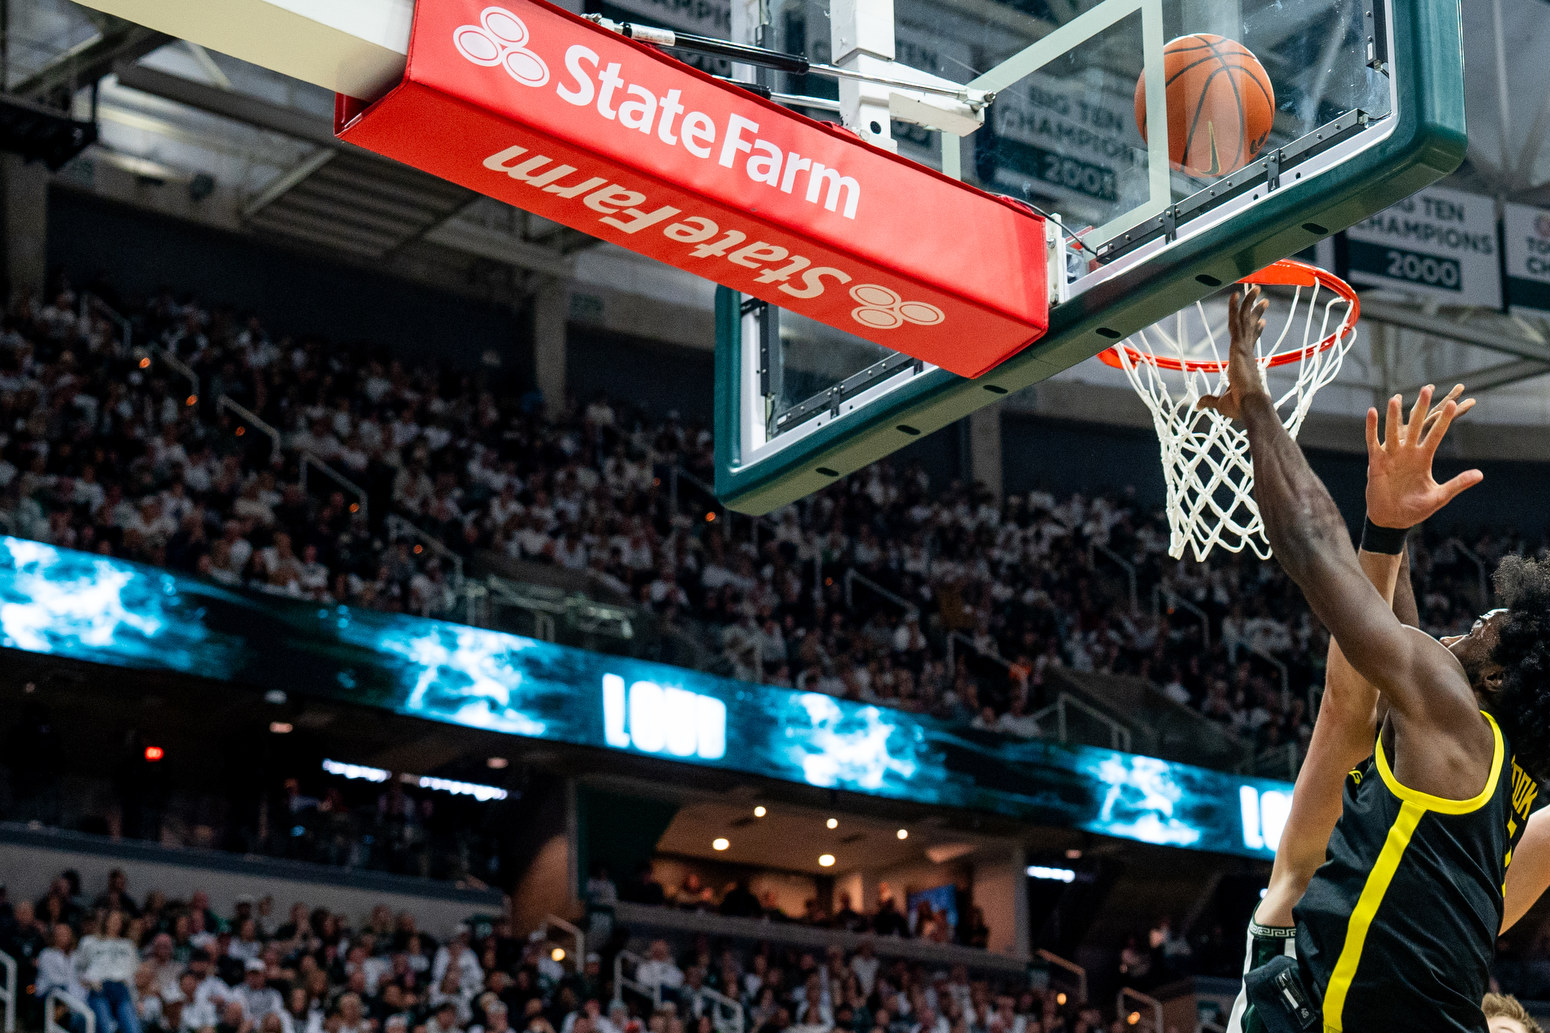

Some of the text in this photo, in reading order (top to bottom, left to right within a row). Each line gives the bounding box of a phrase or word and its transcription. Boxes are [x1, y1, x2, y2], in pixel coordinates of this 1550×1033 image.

[556, 44, 862, 220] State Farm
[1000, 104, 1148, 166] CHAMPION
[1421, 195, 1465, 222] TEN
[1386, 251, 1459, 287] 2000
